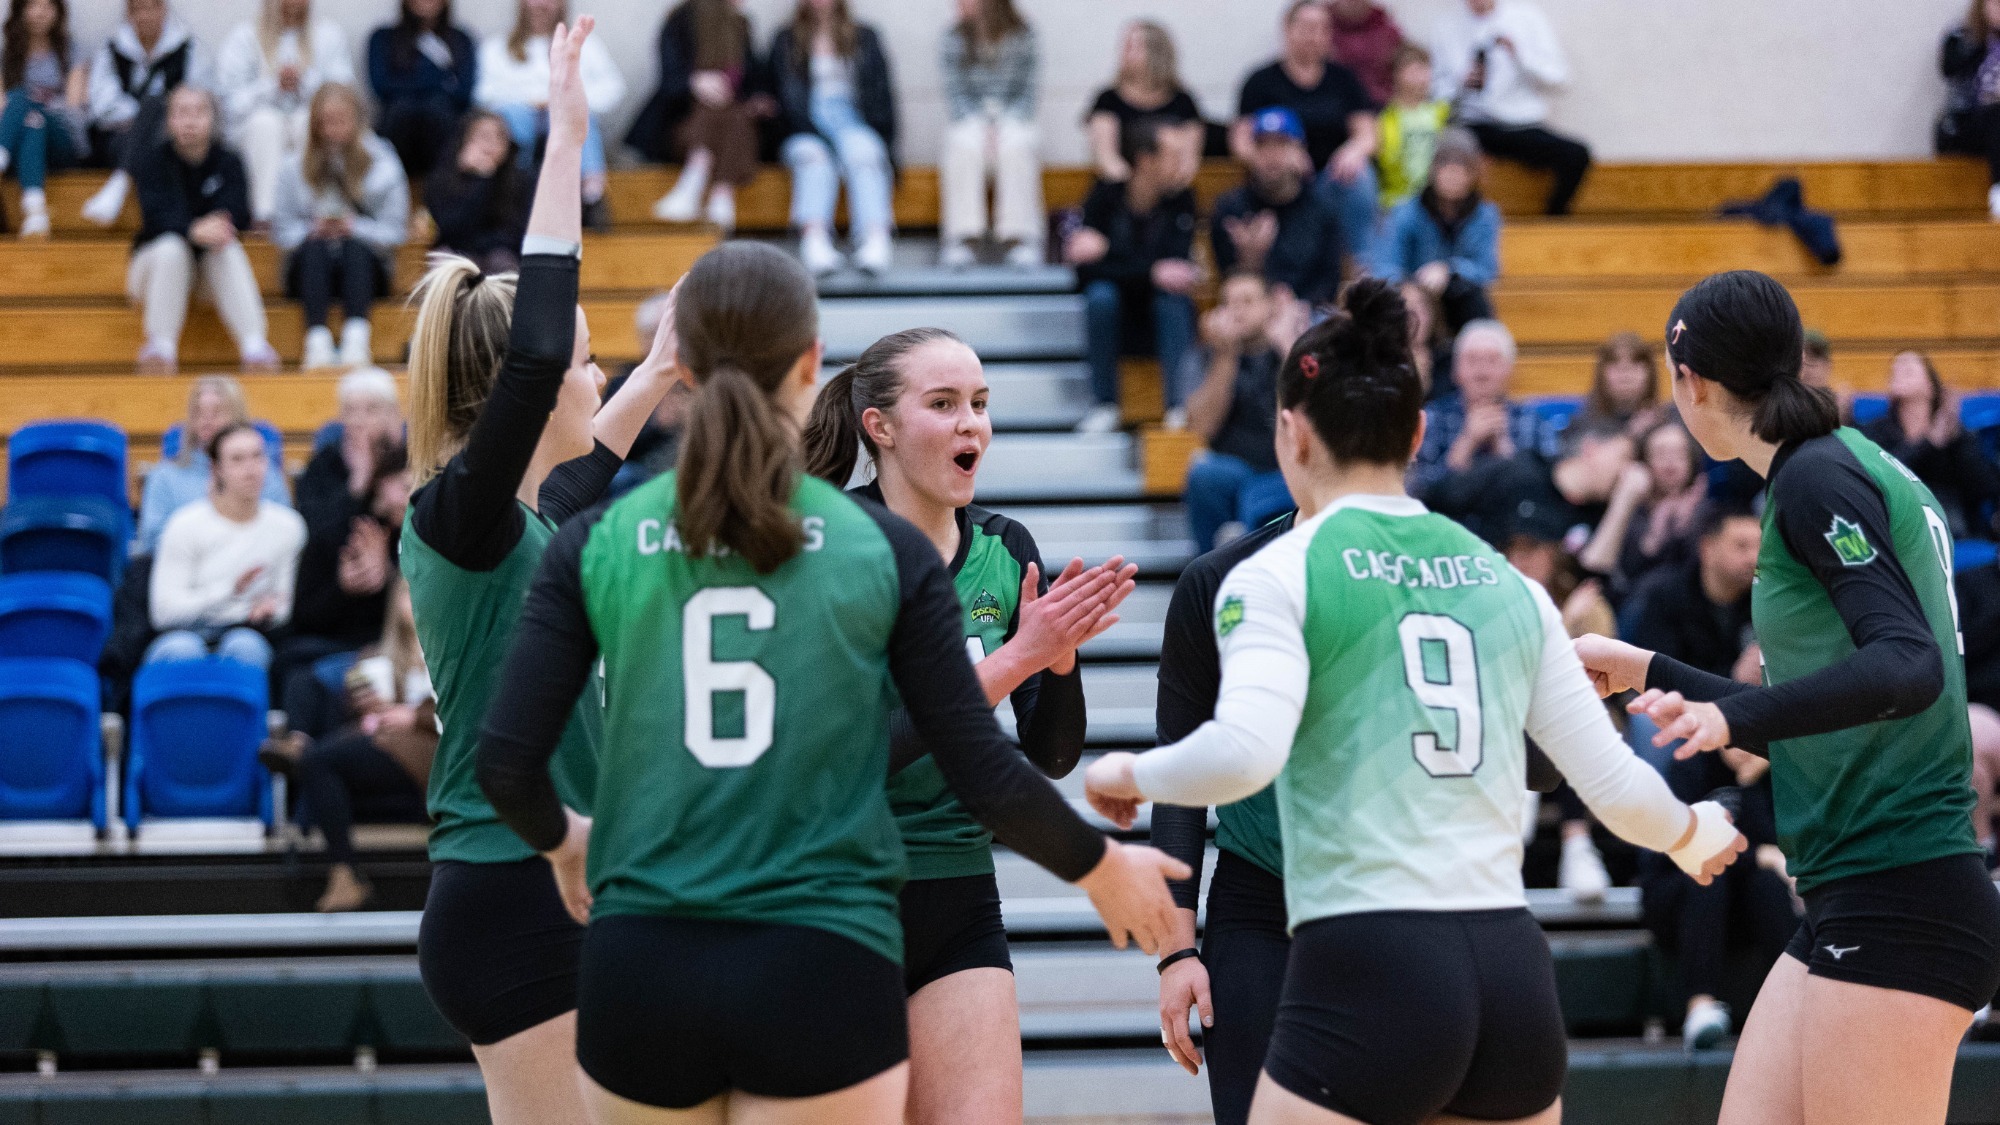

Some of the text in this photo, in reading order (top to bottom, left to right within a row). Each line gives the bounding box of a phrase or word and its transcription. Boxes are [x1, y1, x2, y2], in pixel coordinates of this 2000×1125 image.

[980, 614, 994, 623] UFV
[1342, 548, 1498, 589] CASCADES
[682, 586, 776, 768] 6
[1398, 612, 1484, 778] 9
